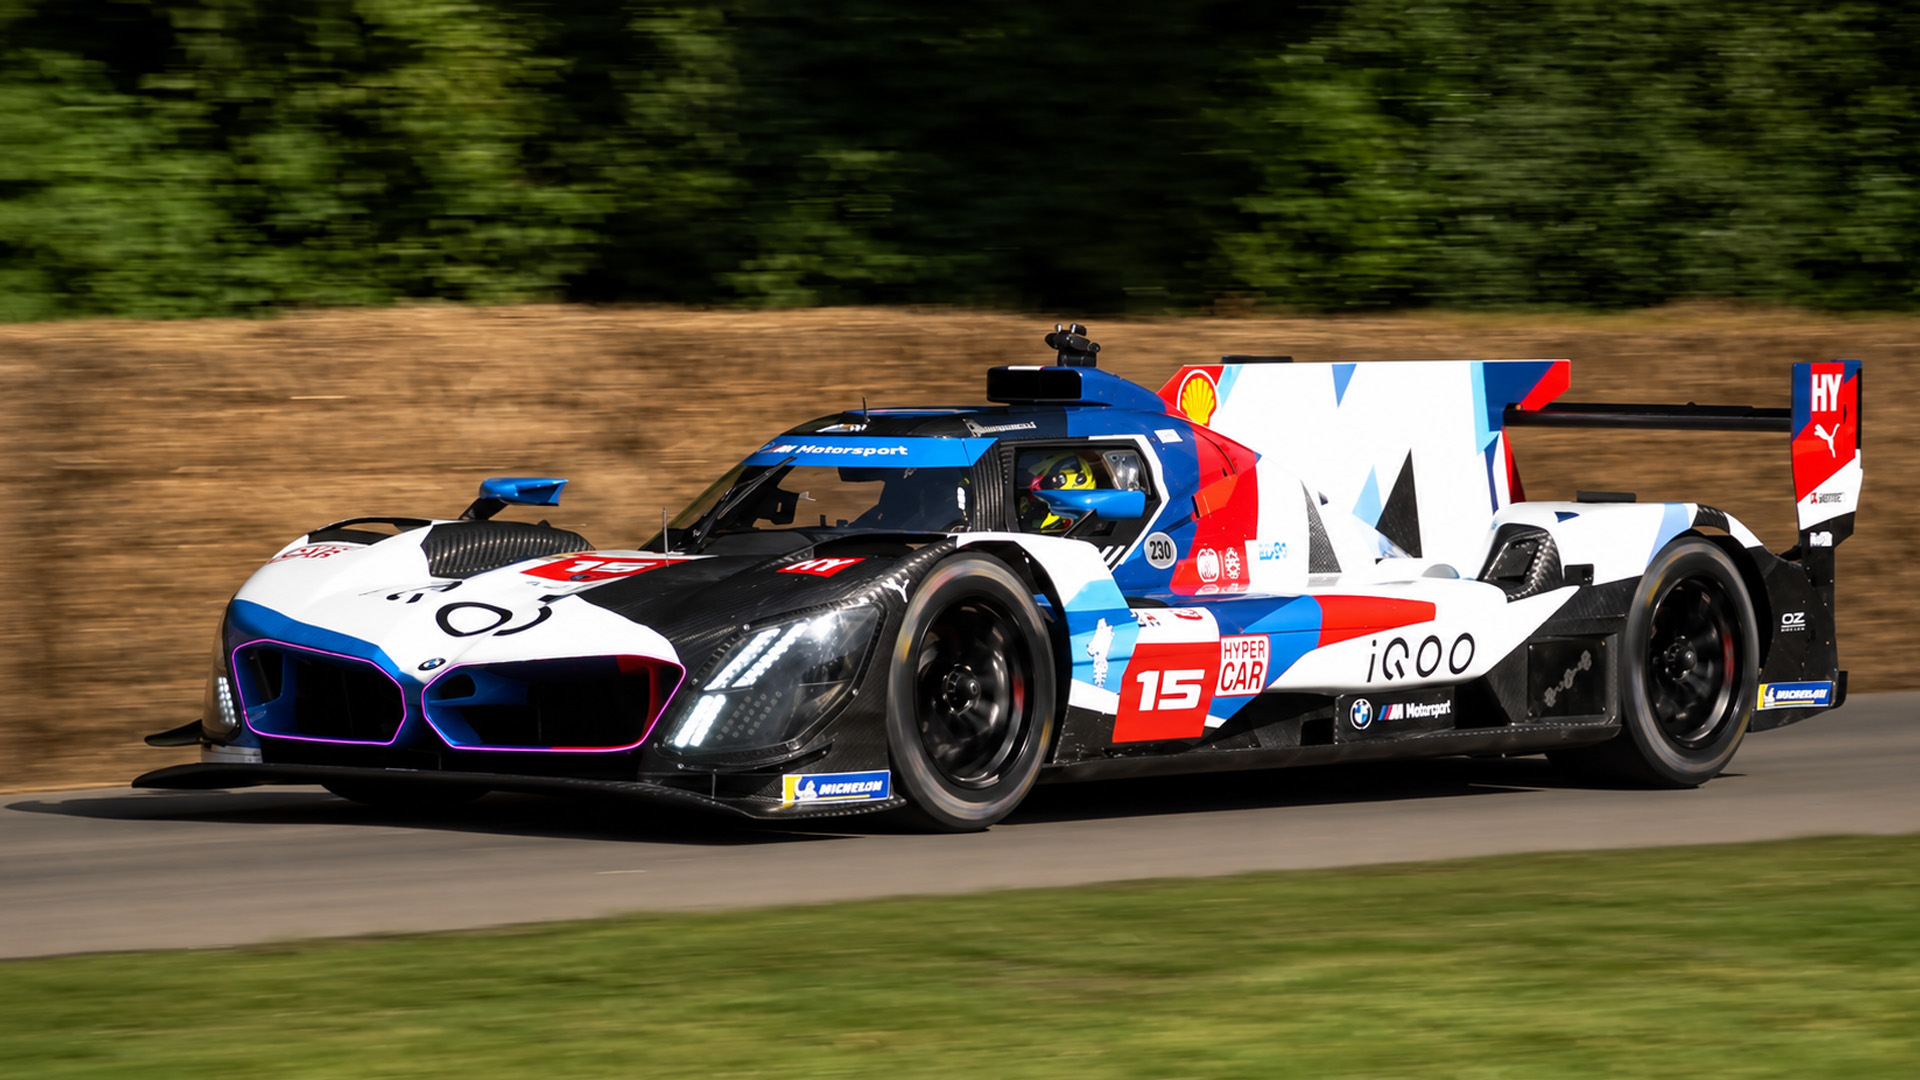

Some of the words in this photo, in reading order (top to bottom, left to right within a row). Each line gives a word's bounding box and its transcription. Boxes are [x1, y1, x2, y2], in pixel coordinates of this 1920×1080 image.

[1812, 374, 1842, 411] HY
[795, 445, 908, 457] Motorsport
[1149, 541, 1171, 560] 230
[565, 560, 657, 573] 15
[785, 559, 855, 572] HY
[1782, 612, 1805, 624] OZ
[1223, 640, 1265, 659] HYPER
[1366, 632, 1475, 683] iQOO
[1221, 660, 1264, 691] CAR
[1136, 669, 1205, 711] 15
[1406, 700, 1451, 718] Motorsport
